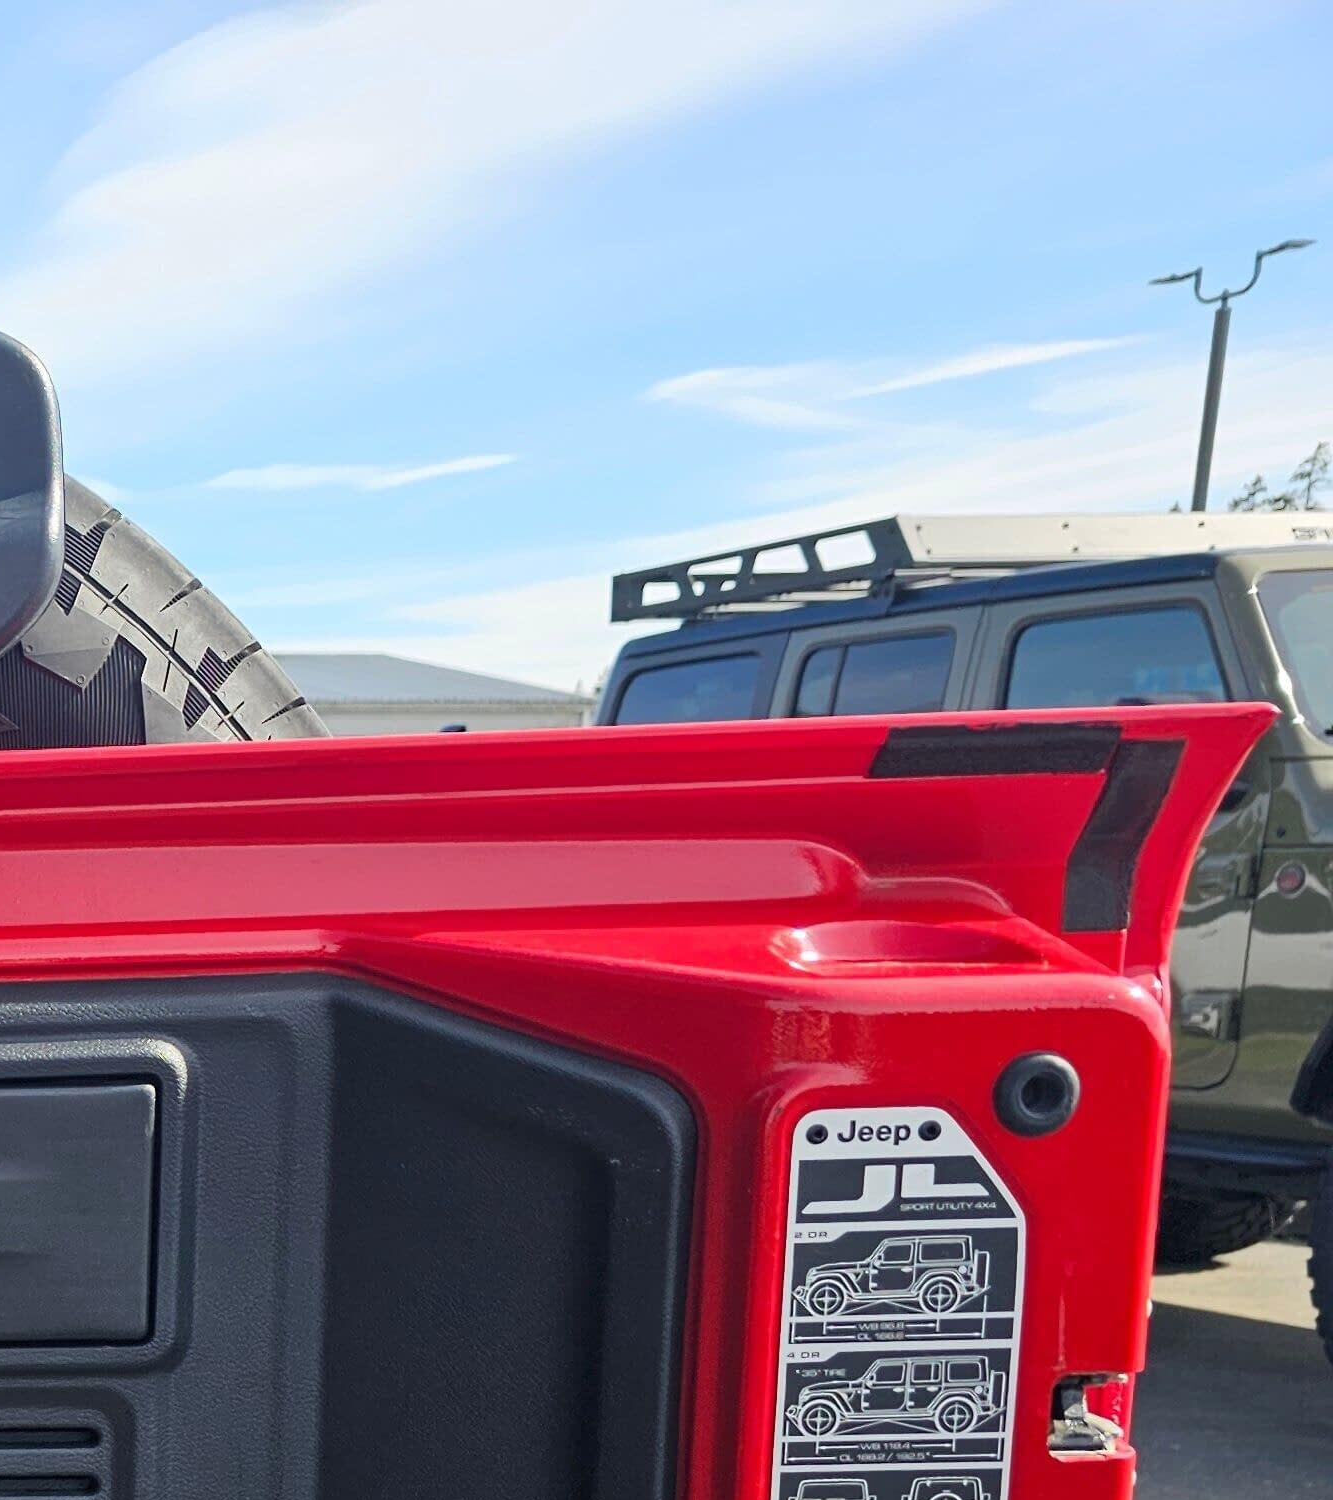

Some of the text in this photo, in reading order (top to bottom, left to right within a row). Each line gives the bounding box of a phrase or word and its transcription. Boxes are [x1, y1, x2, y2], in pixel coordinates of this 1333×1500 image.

[837, 1121, 911, 1145] Jeep
[802, 1163, 990, 1214] JL
[900, 1201, 997, 1212] SPORT UTILITY 4X4
[794, 1231, 828, 1239] 2 DR
[860, 1442, 881, 1450] WB
